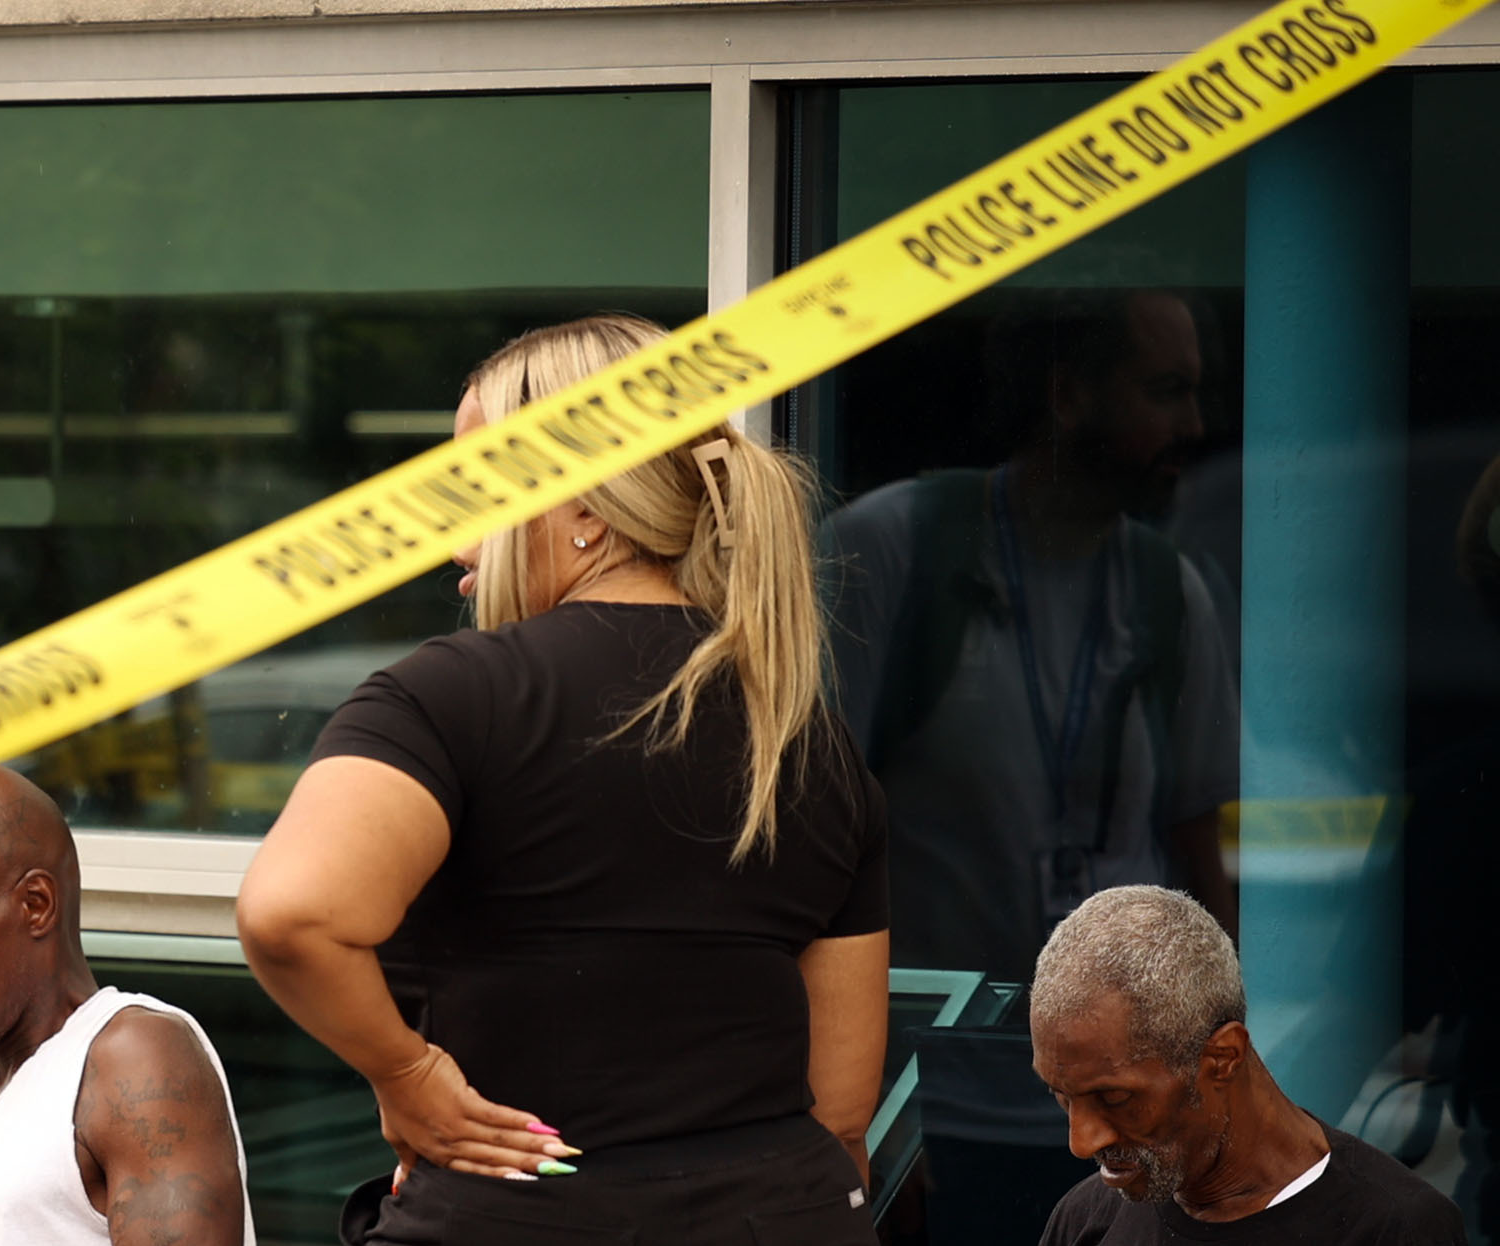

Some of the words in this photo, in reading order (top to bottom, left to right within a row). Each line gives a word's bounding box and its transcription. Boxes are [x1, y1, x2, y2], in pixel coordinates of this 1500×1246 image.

[900, 182, 1058, 282] POLICE
[1026, 135, 1140, 211] LINE
[1110, 104, 1191, 166] DO
[1163, 61, 1263, 138] NOT
[1239, 0, 1378, 93] CROSS
[253, 505, 419, 606] POLICE
[390, 464, 506, 533] LINE
[481, 435, 566, 490] DO
[539, 394, 645, 459] NOT
[619, 329, 770, 420] CROSS
